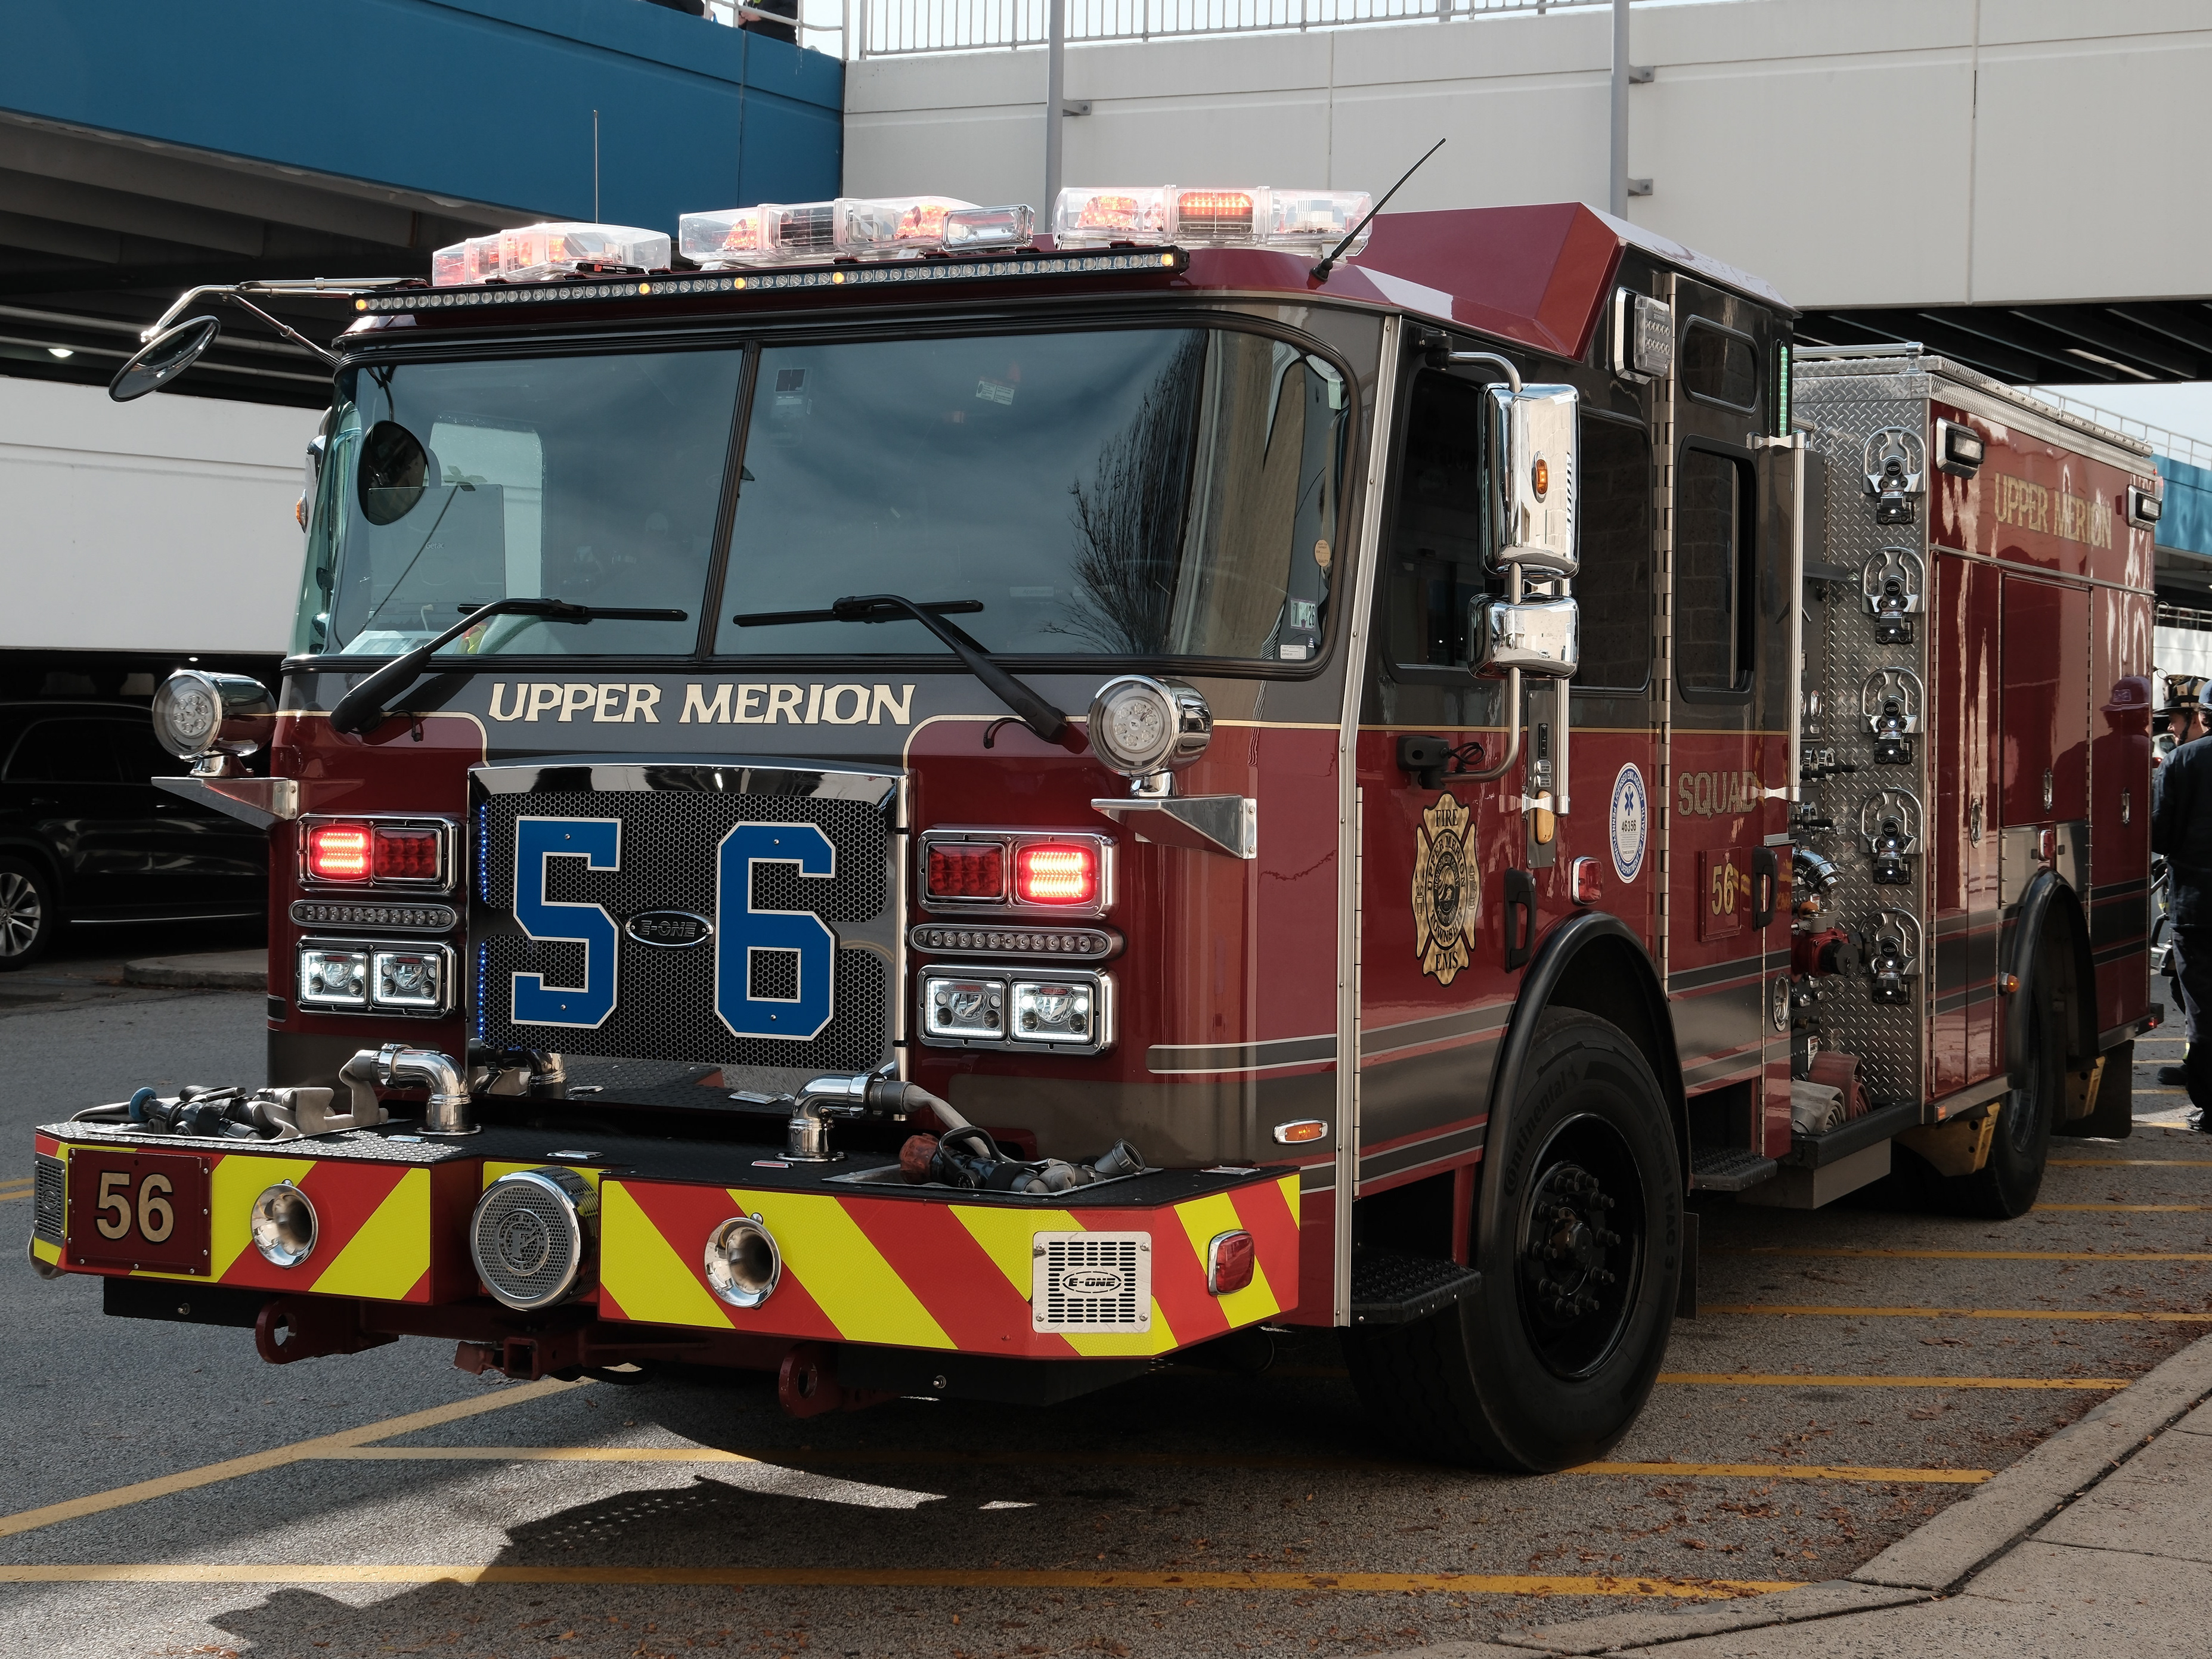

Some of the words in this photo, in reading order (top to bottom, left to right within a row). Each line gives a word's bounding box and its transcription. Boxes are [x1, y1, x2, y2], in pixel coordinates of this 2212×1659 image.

[1994, 472, 2049, 534] UPPER
[2053, 491, 2112, 550] MERION
[1309, 605, 1315, 626] 26
[488, 682, 662, 724] UPPER
[679, 683, 916, 725] MERION
[1614, 773, 1627, 804] LICENSED
[1634, 774, 1644, 801] AGENCY
[1678, 771, 1757, 820] SQUAD
[1435, 808, 1458, 827] FIRE
[1621, 820, 1637, 833] 46356
[1427, 840, 1445, 892] UPPER
[1445, 836, 1466, 888] MERION
[1621, 855, 1640, 875] DEPARTMENT
[1638, 844, 1643, 854] OF
[1711, 863, 1735, 916] 56
[639, 920, 697, 938] E-ONE
[1430, 907, 1463, 942] TOWNSHIP
[1435, 951, 1458, 971] EMS
[1504, 1068, 1568, 1197] Continental
[1651, 1122, 1672, 1187] Conti
[94, 1170, 175, 1244] 56
[1665, 1192, 1675, 1246] HAC
[1665, 1255, 1675, 1270] 3
[1068, 1277, 1116, 1287] E-ONE
